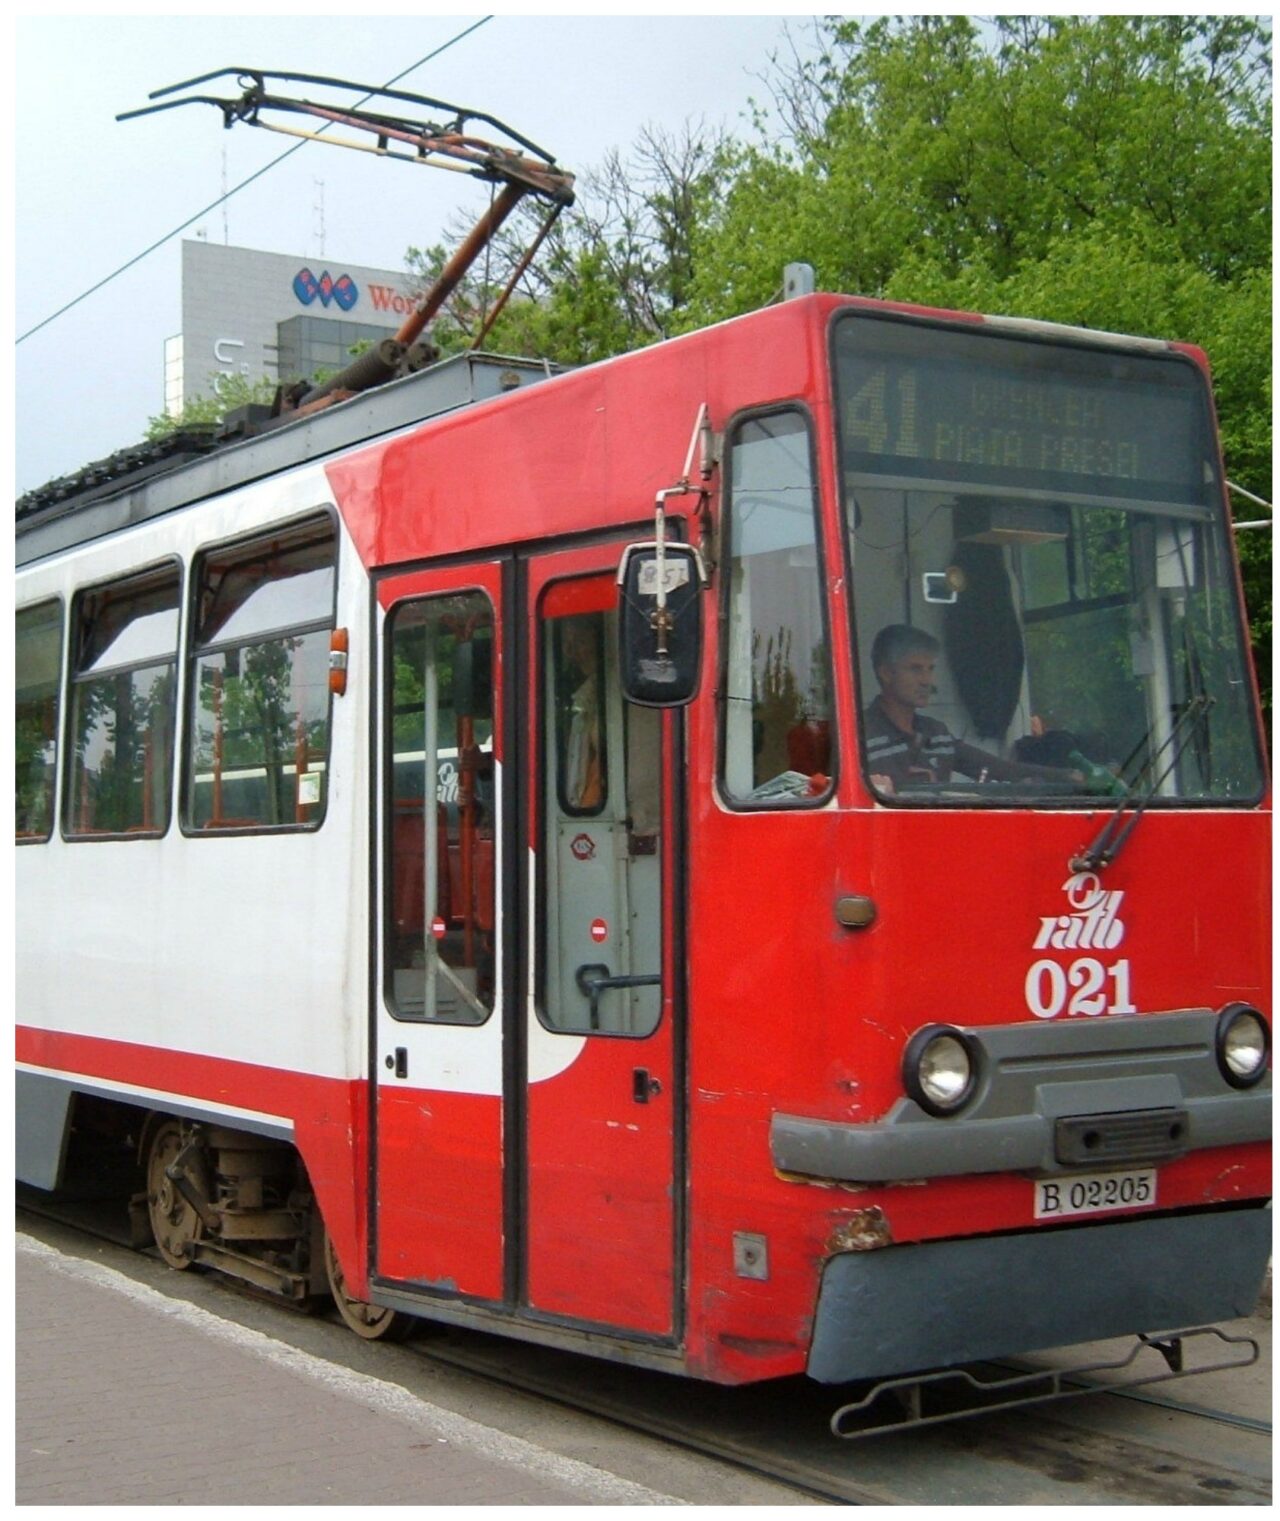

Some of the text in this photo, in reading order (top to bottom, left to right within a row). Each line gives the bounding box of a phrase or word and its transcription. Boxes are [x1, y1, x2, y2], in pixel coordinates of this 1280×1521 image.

[847, 369, 919, 457] 41
[1032, 882, 1126, 950] ratb
[1025, 957, 1137, 1019] 021
[1042, 1177, 1150, 1213] B 02205
